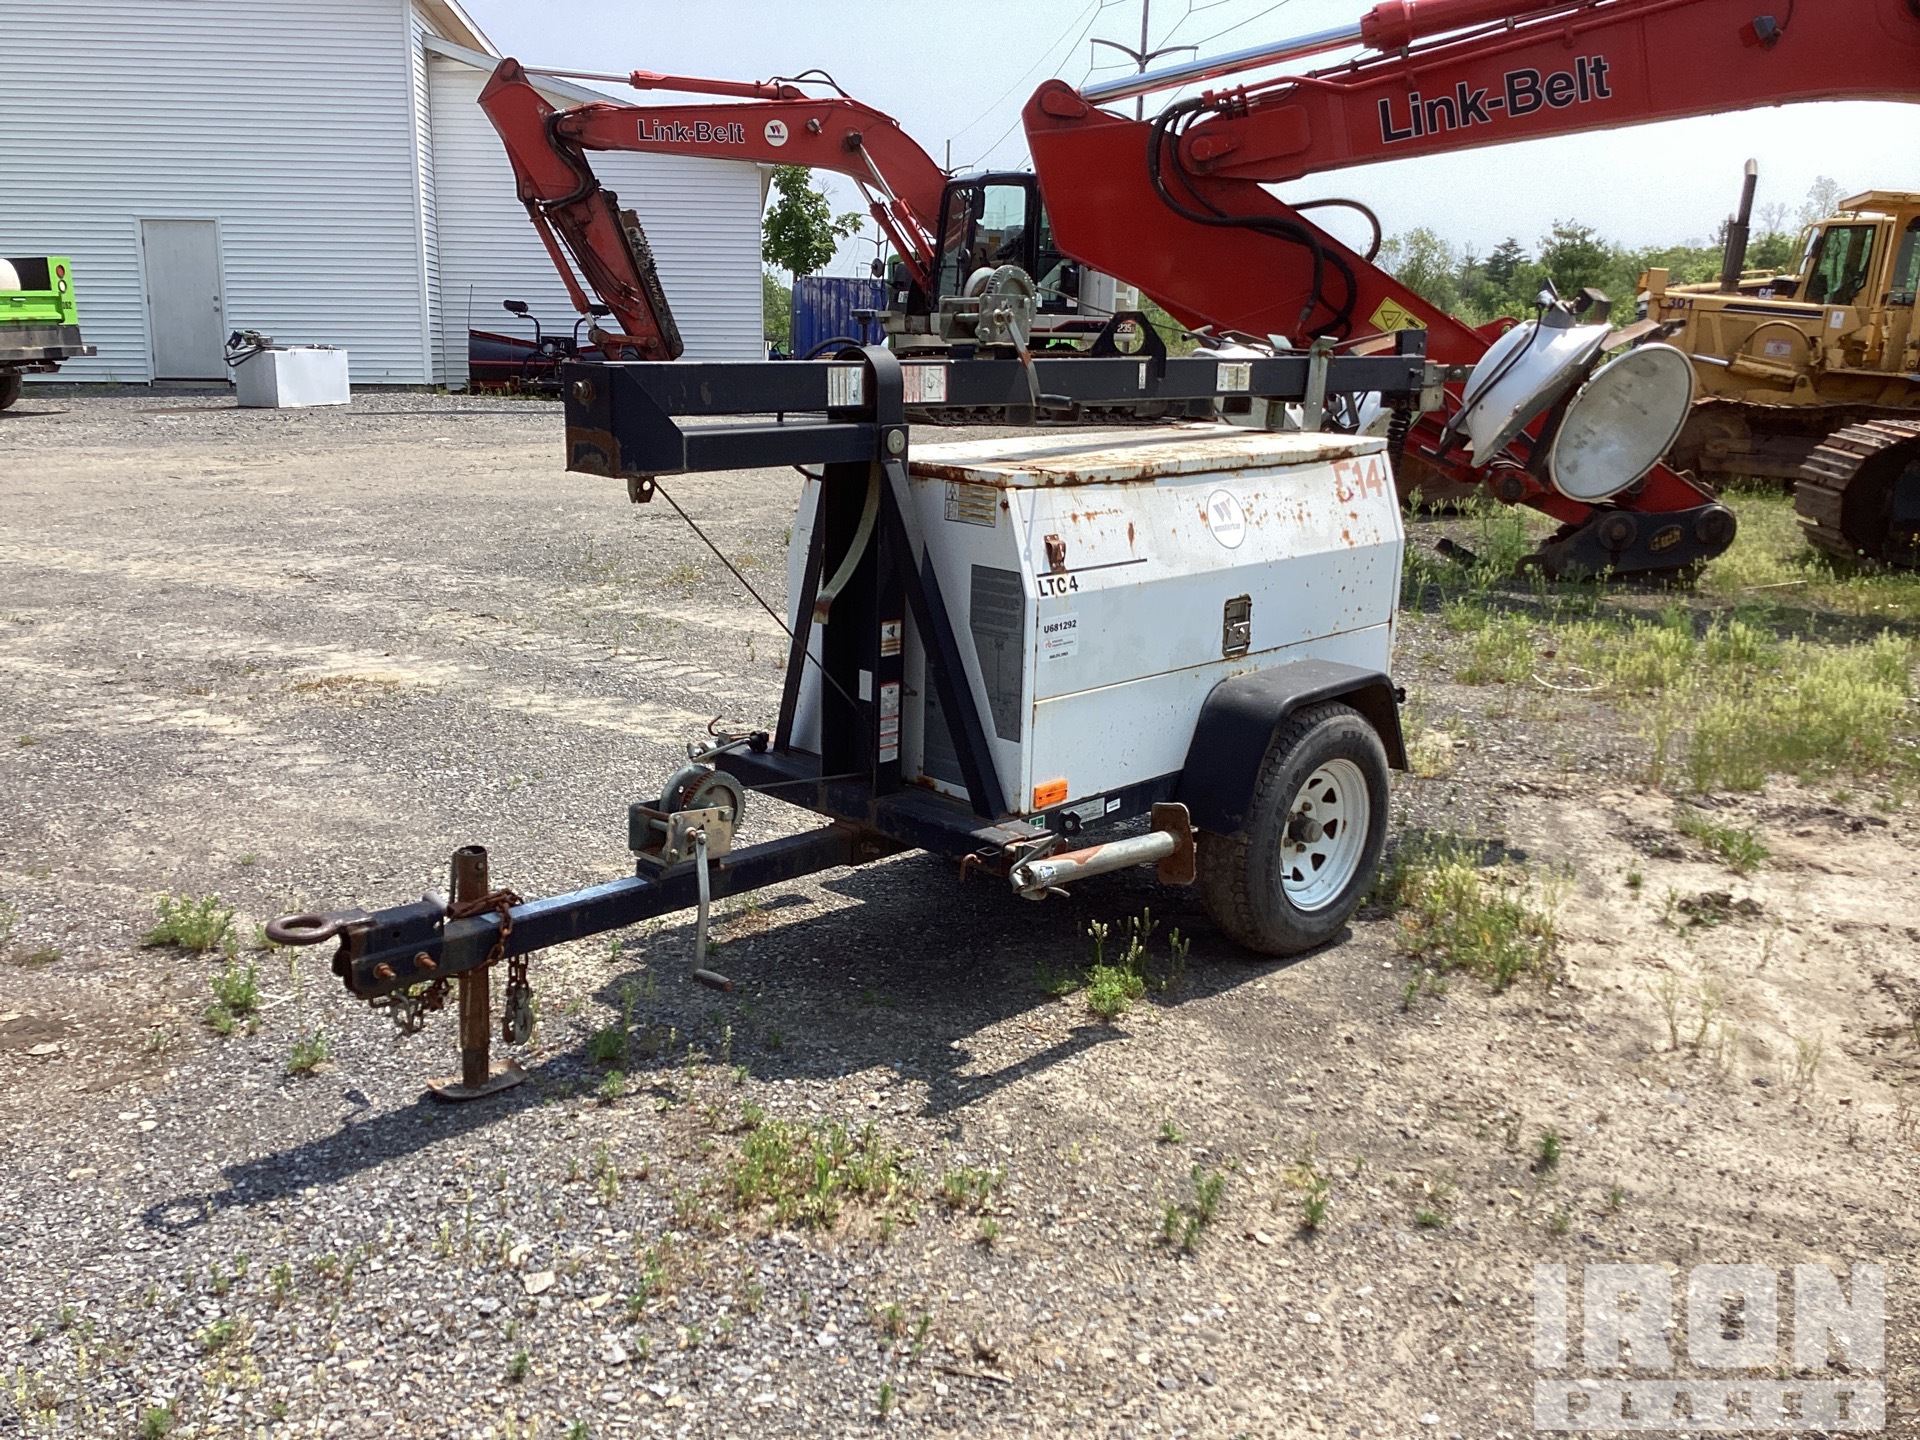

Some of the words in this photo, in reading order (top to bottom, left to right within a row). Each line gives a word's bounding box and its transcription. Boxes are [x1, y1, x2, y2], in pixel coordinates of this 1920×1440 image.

[1378, 55, 1611, 143] Link-Belt
[637, 119, 745, 143] Link-Belt
[1037, 575, 1079, 597] LTC4
[1043, 619, 1077, 634] U681292
